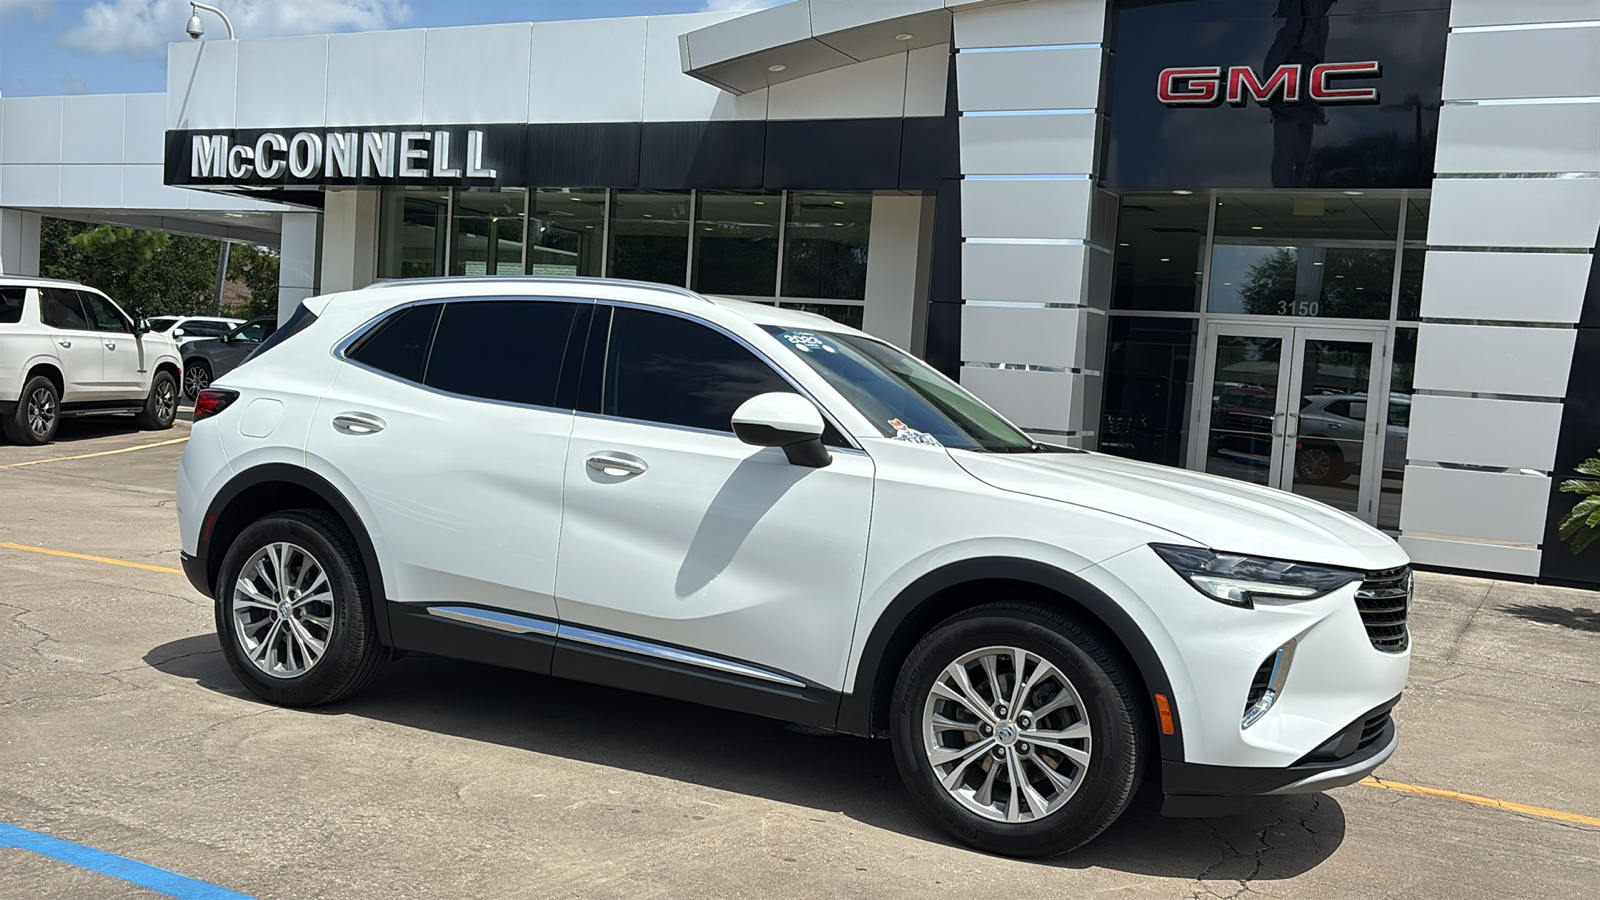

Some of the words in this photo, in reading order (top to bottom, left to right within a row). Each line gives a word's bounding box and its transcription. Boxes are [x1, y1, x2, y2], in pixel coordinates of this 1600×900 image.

[1157, 61, 1381, 106] GMC
[191, 130, 497, 179] McCONNELL
[1276, 300, 1319, 316] 3150
